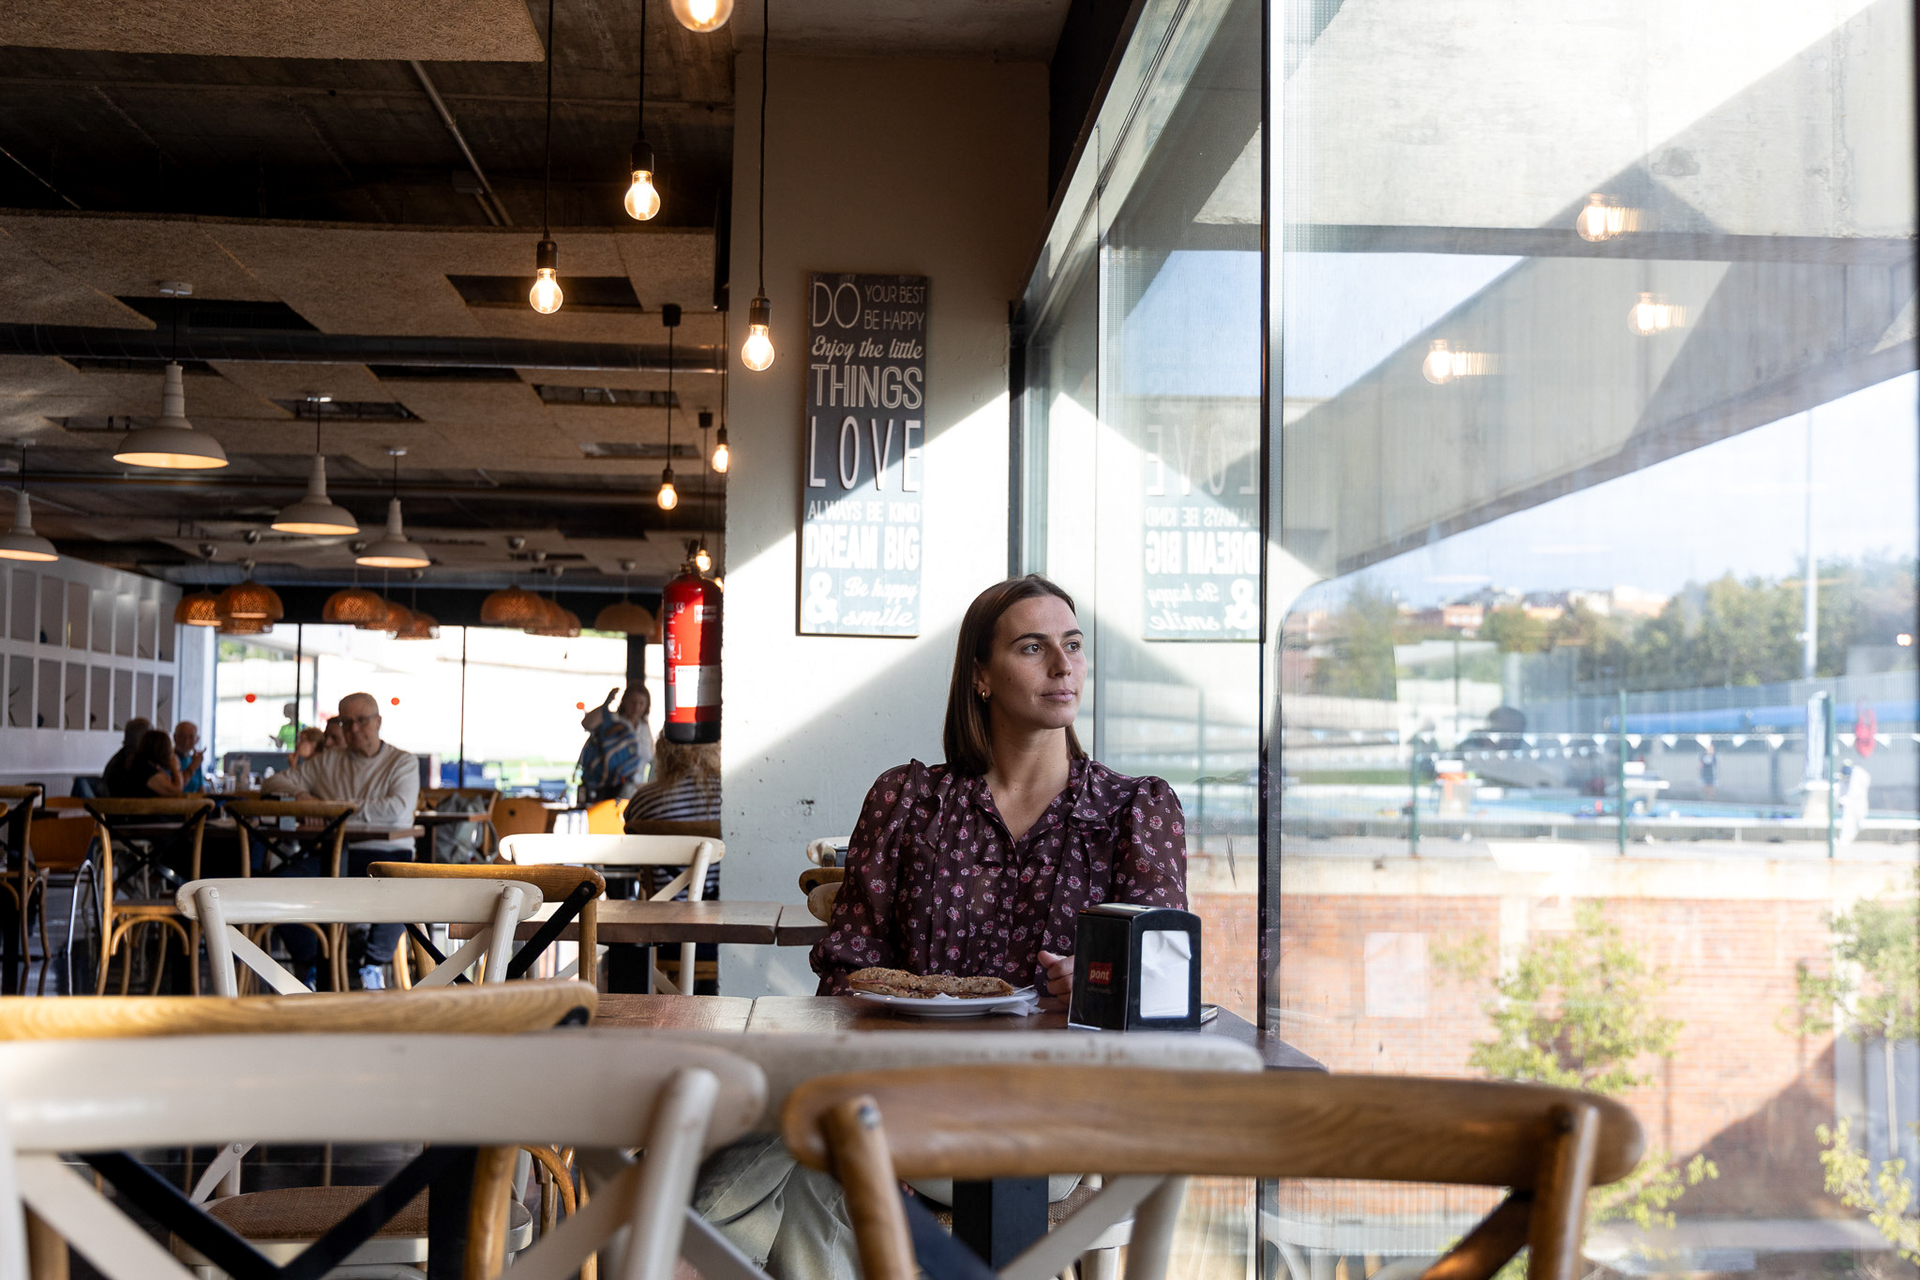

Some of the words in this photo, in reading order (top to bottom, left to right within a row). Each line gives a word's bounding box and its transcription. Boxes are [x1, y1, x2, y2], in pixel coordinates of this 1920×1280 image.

[812, 282, 861, 329] DO
[864, 285, 897, 303] YOUR
[899, 286, 926, 304] BEST
[864, 310, 880, 330] BE
[883, 311, 925, 330] HAPPY
[811, 335, 855, 364] Enjoy
[858, 337, 884, 358] the
[888, 338, 923, 359] little
[811, 364, 923, 410] THINGS
[809, 416, 921, 491] LOVE
[807, 500, 862, 521] ALWAYS
[866, 502, 884, 522] BE
[888, 503, 920, 523] KIND
[805, 524, 878, 569] DREAM
[884, 526, 920, 571] BIG
[804, 571, 838, 625] &
[843, 576, 869, 598] Be
[871, 578, 918, 605] happy
[842, 605, 916, 628] smile
[1089, 969, 1110, 981] pont
